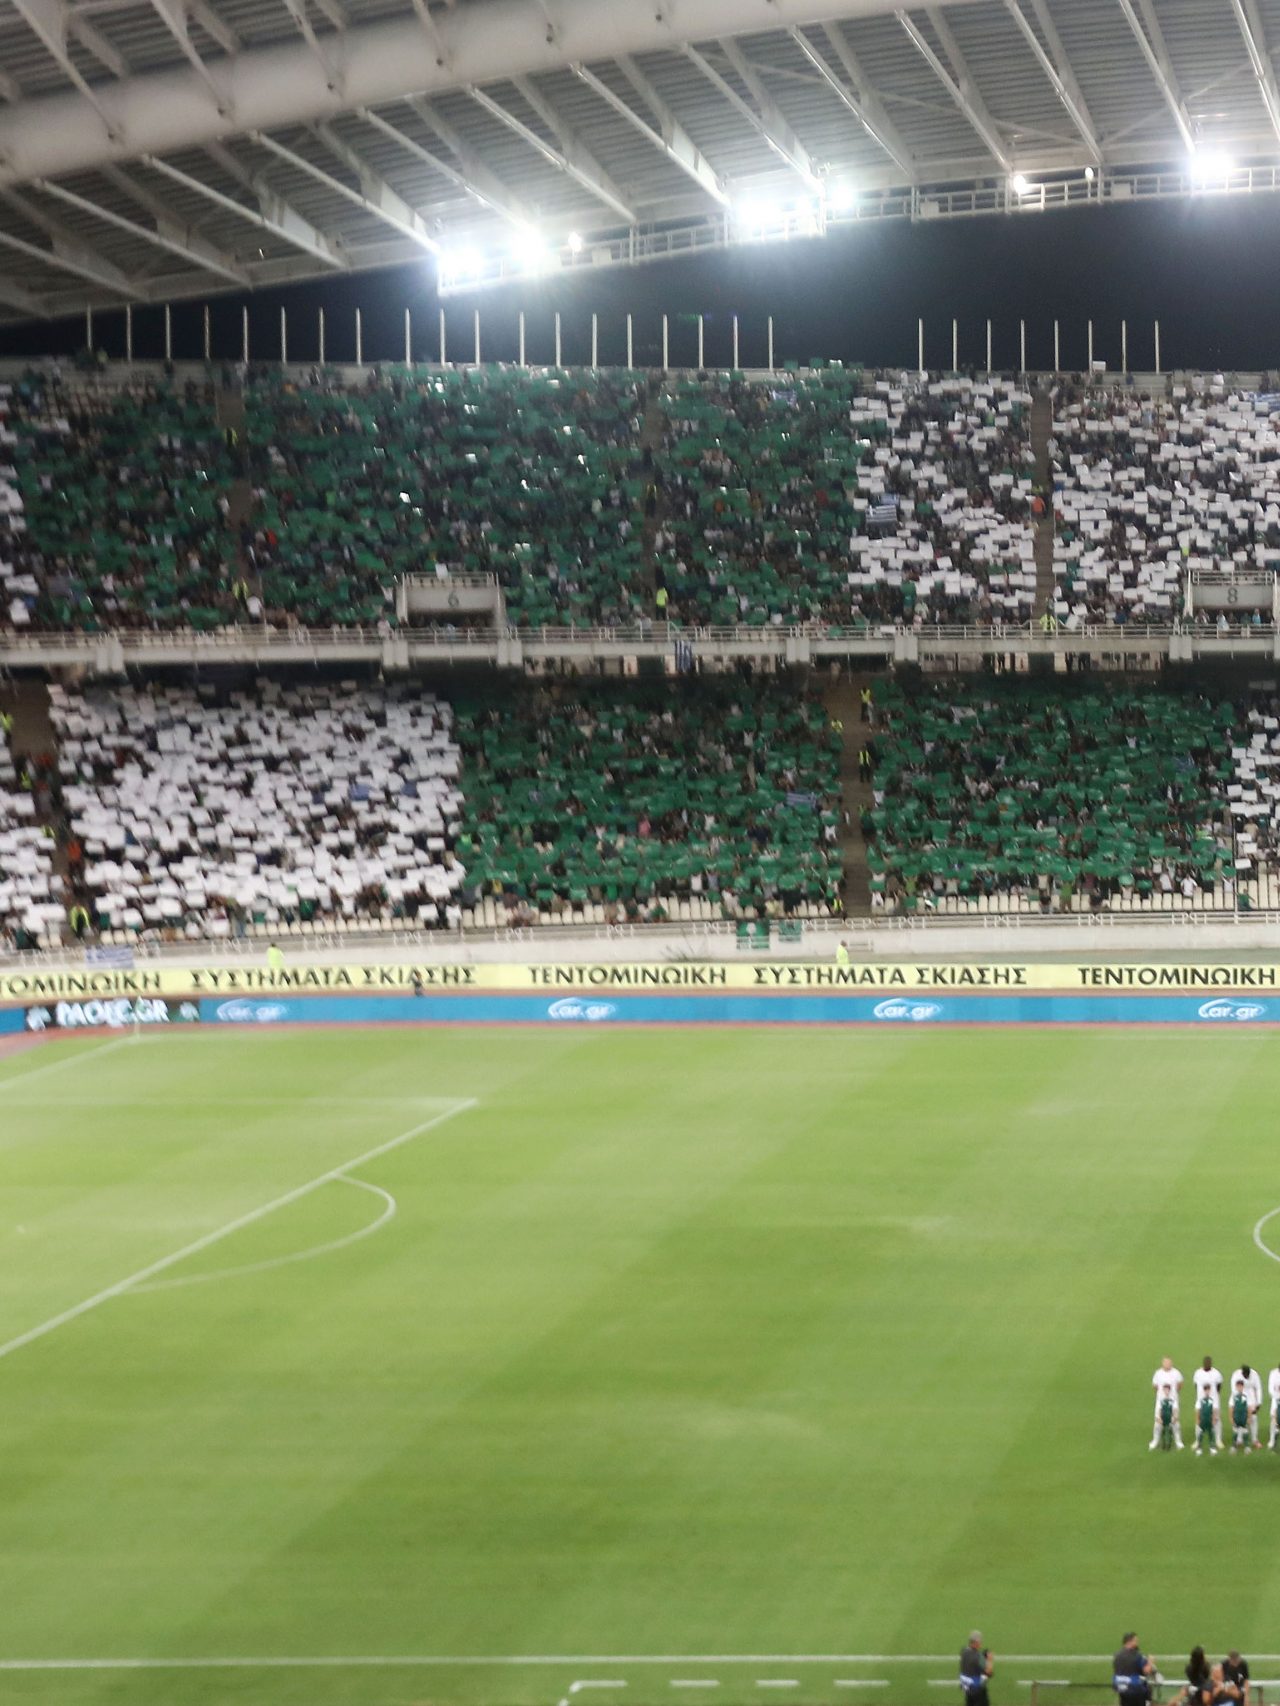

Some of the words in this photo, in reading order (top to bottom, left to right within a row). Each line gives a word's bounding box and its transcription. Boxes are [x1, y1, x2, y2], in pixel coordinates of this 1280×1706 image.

[1227, 586, 1238, 604] 8
[0, 972, 161, 996] ΟΜΙΝΩΙΚΗ
[191, 967, 352, 987] ΣΥΣΤΗΜΑΤΑ
[362, 966, 476, 985] ΣΚΙΑΣΗΣ
[530, 966, 726, 985] ΤΕΝΤΟΜΙΝΩΙΚΗ
[754, 967, 906, 985] ΣΥΣΤΗΜΑΤΑ
[916, 967, 1027, 985] ΣΚΙΑΣΗΣ
[1078, 967, 1275, 985] ΤΕΝΤΟΜΙΝΩΙΚΗ
